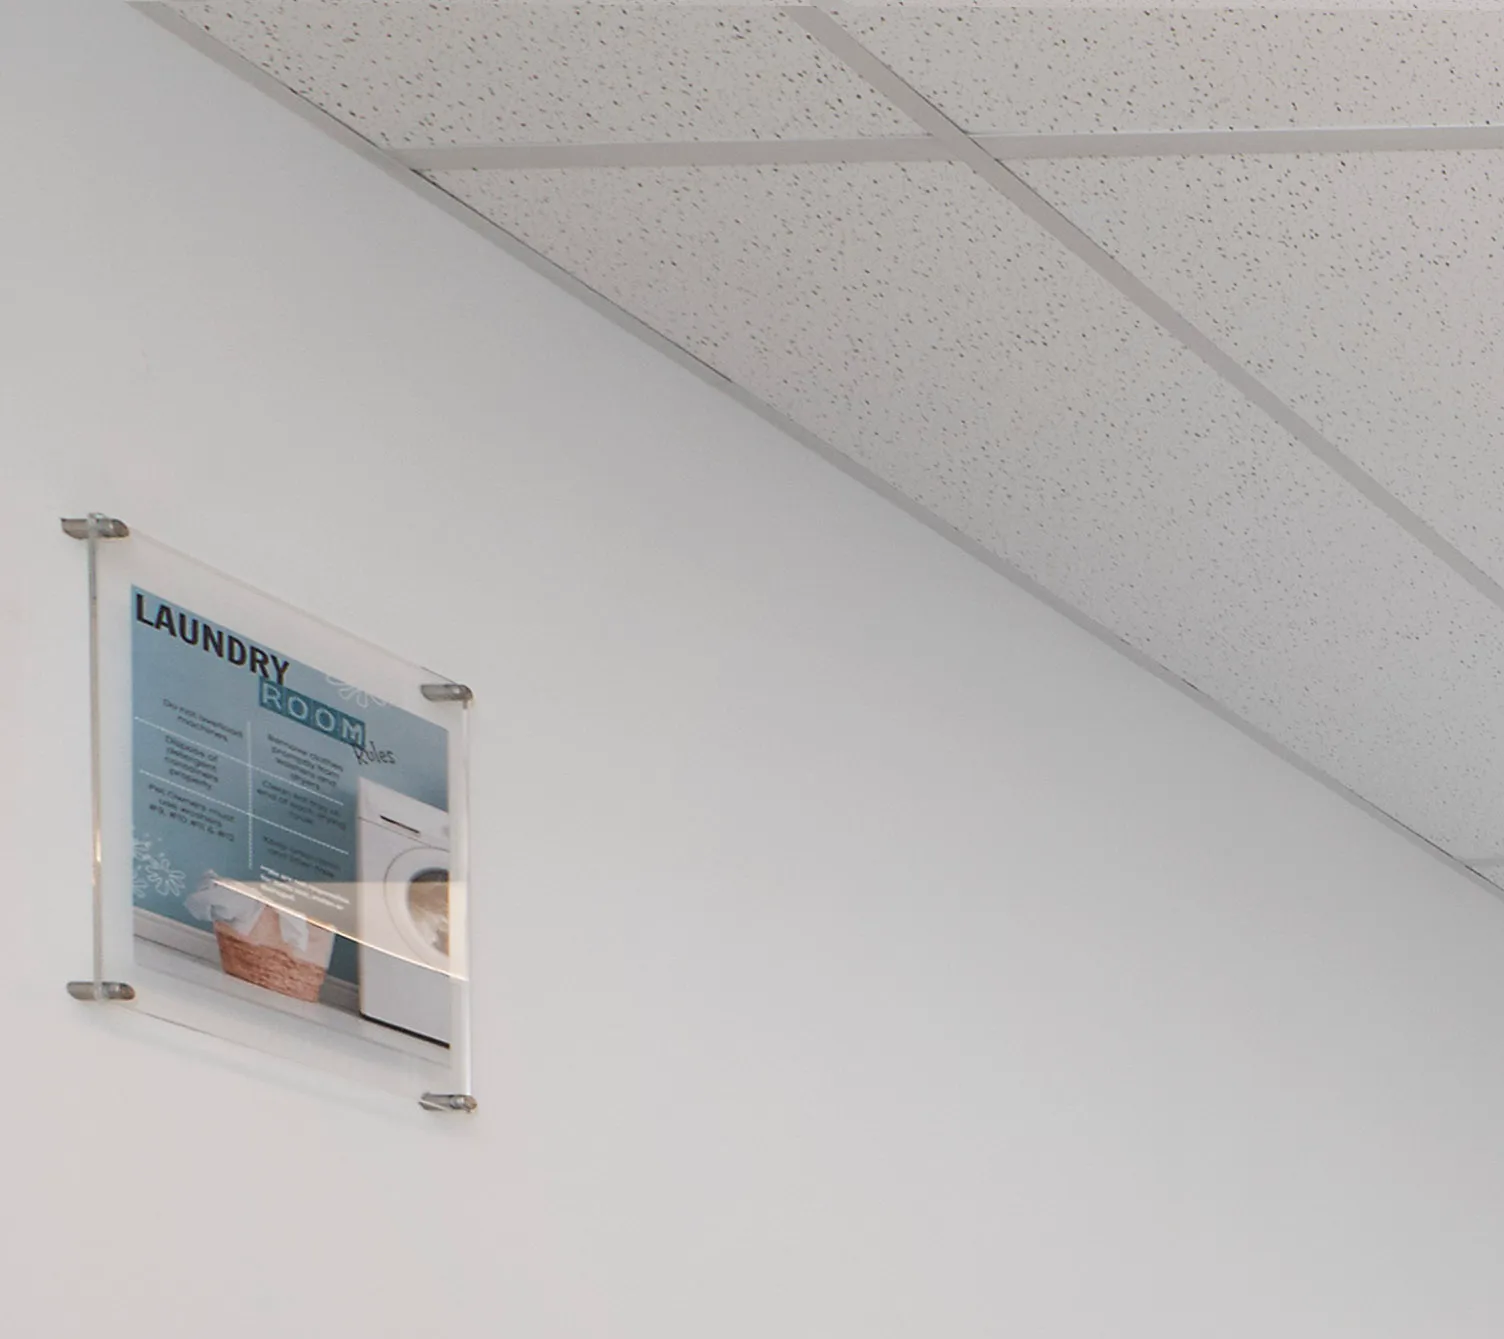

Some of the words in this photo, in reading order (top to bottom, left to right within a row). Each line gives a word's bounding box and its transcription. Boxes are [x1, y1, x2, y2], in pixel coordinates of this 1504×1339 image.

[136, 593, 290, 686] LAUNDRY
[262, 683, 363, 747] ROOM
[353, 740, 397, 766] Rules
